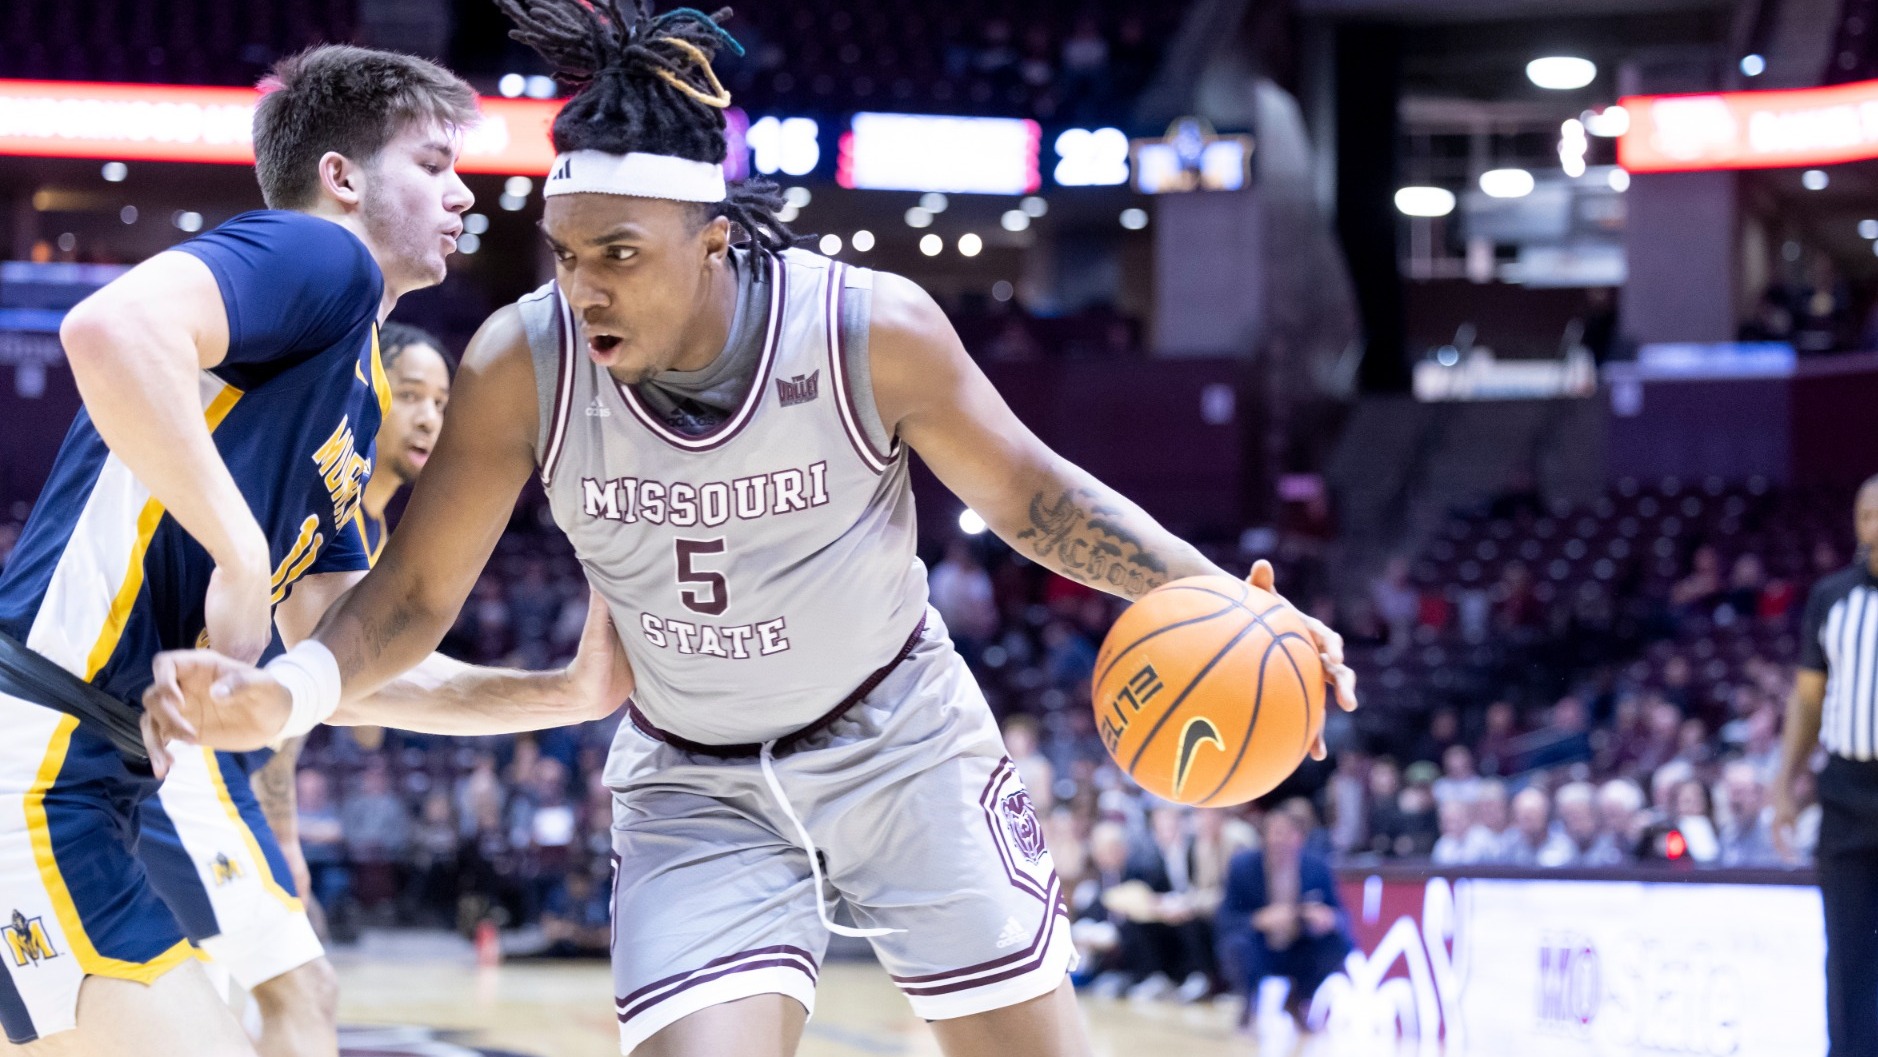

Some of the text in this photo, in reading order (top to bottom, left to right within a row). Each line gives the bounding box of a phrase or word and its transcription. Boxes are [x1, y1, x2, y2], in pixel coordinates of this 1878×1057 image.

[1055, 127, 1129, 186] 22
[582, 460, 829, 528] MISSOURI
[673, 535, 731, 616] 5
[640, 612, 790, 660] STATE
[1101, 664, 1164, 756] ELITE
